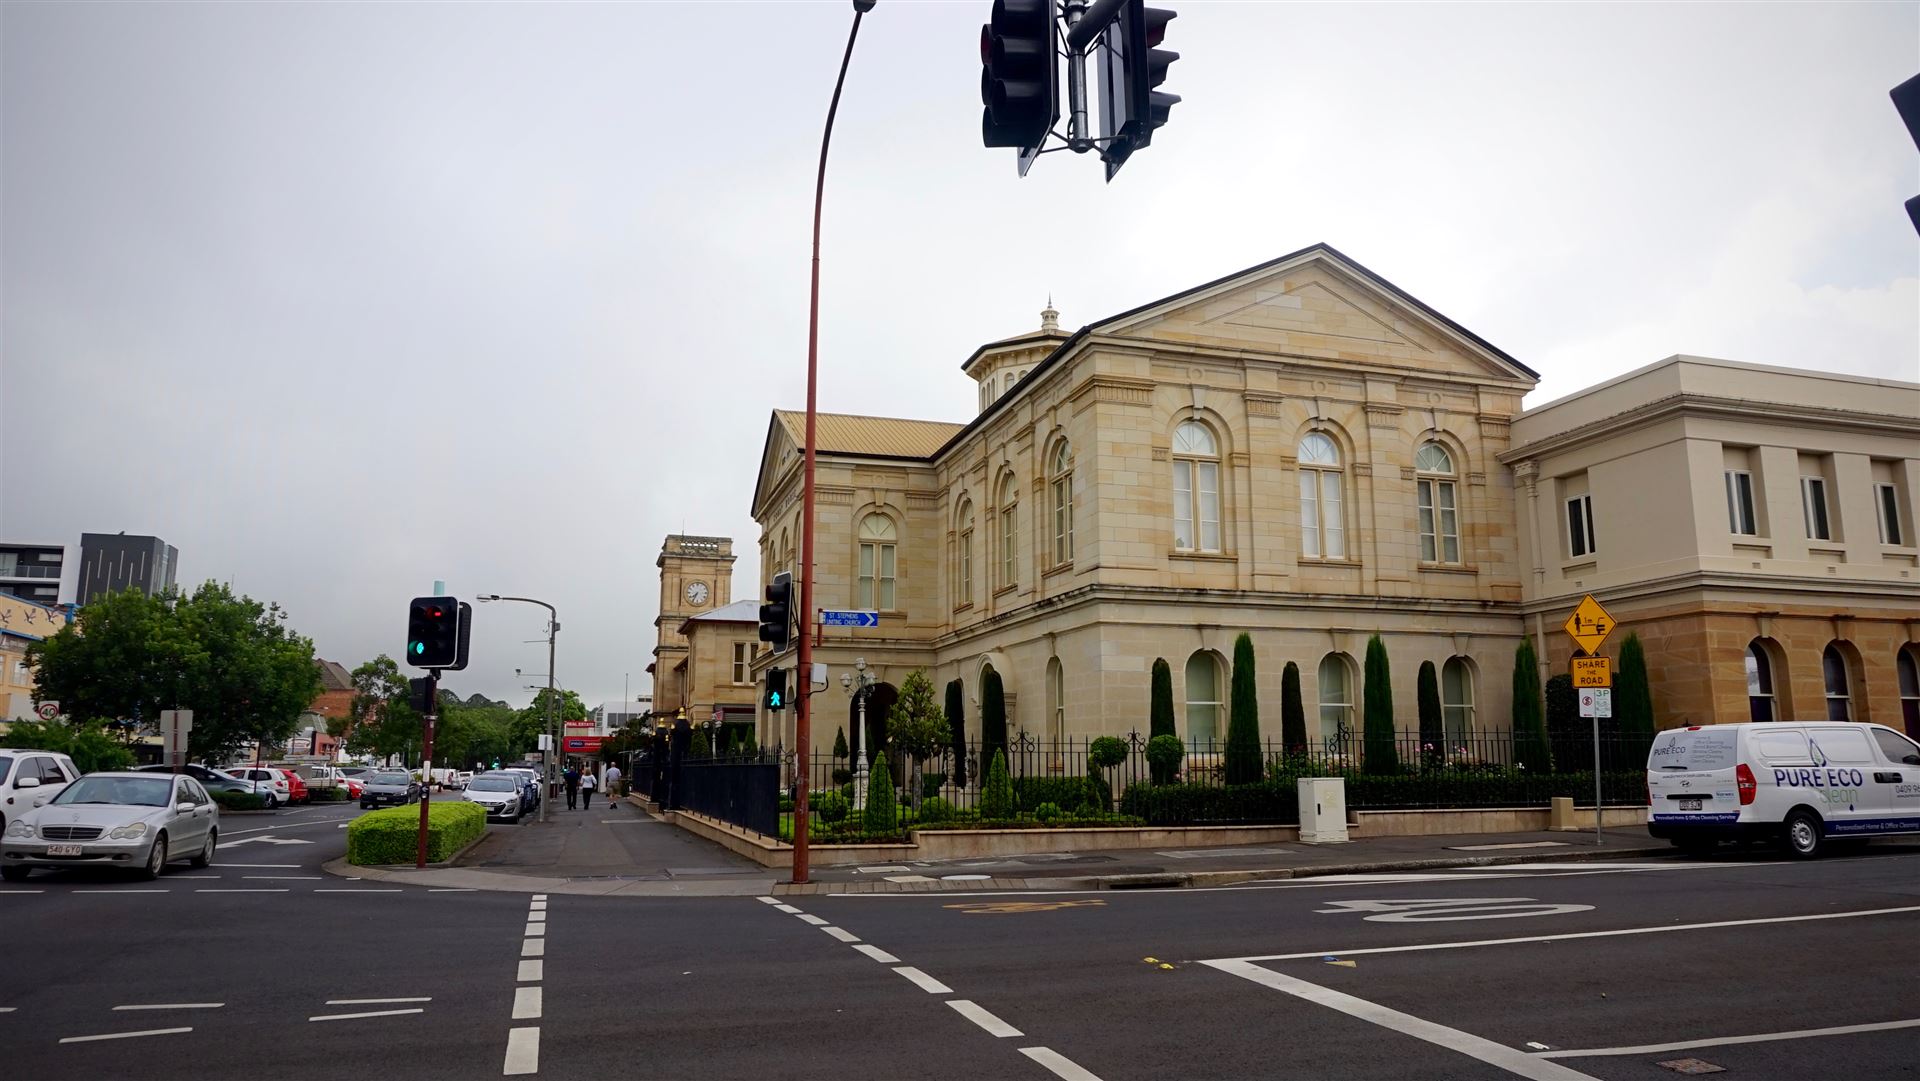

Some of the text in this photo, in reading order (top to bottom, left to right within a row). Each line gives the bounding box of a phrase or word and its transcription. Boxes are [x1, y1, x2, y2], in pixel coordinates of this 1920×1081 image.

[43, 707, 55, 717] 40
[1654, 747, 1670, 756] PURE
[1671, 746, 1686, 754] ECO
[1774, 768, 1863, 787] PURE ECO
[1896, 784, 1911, 793] 0409
[1820, 789, 1859, 804] clean
[1900, 822, 1919, 830] Cleaning
